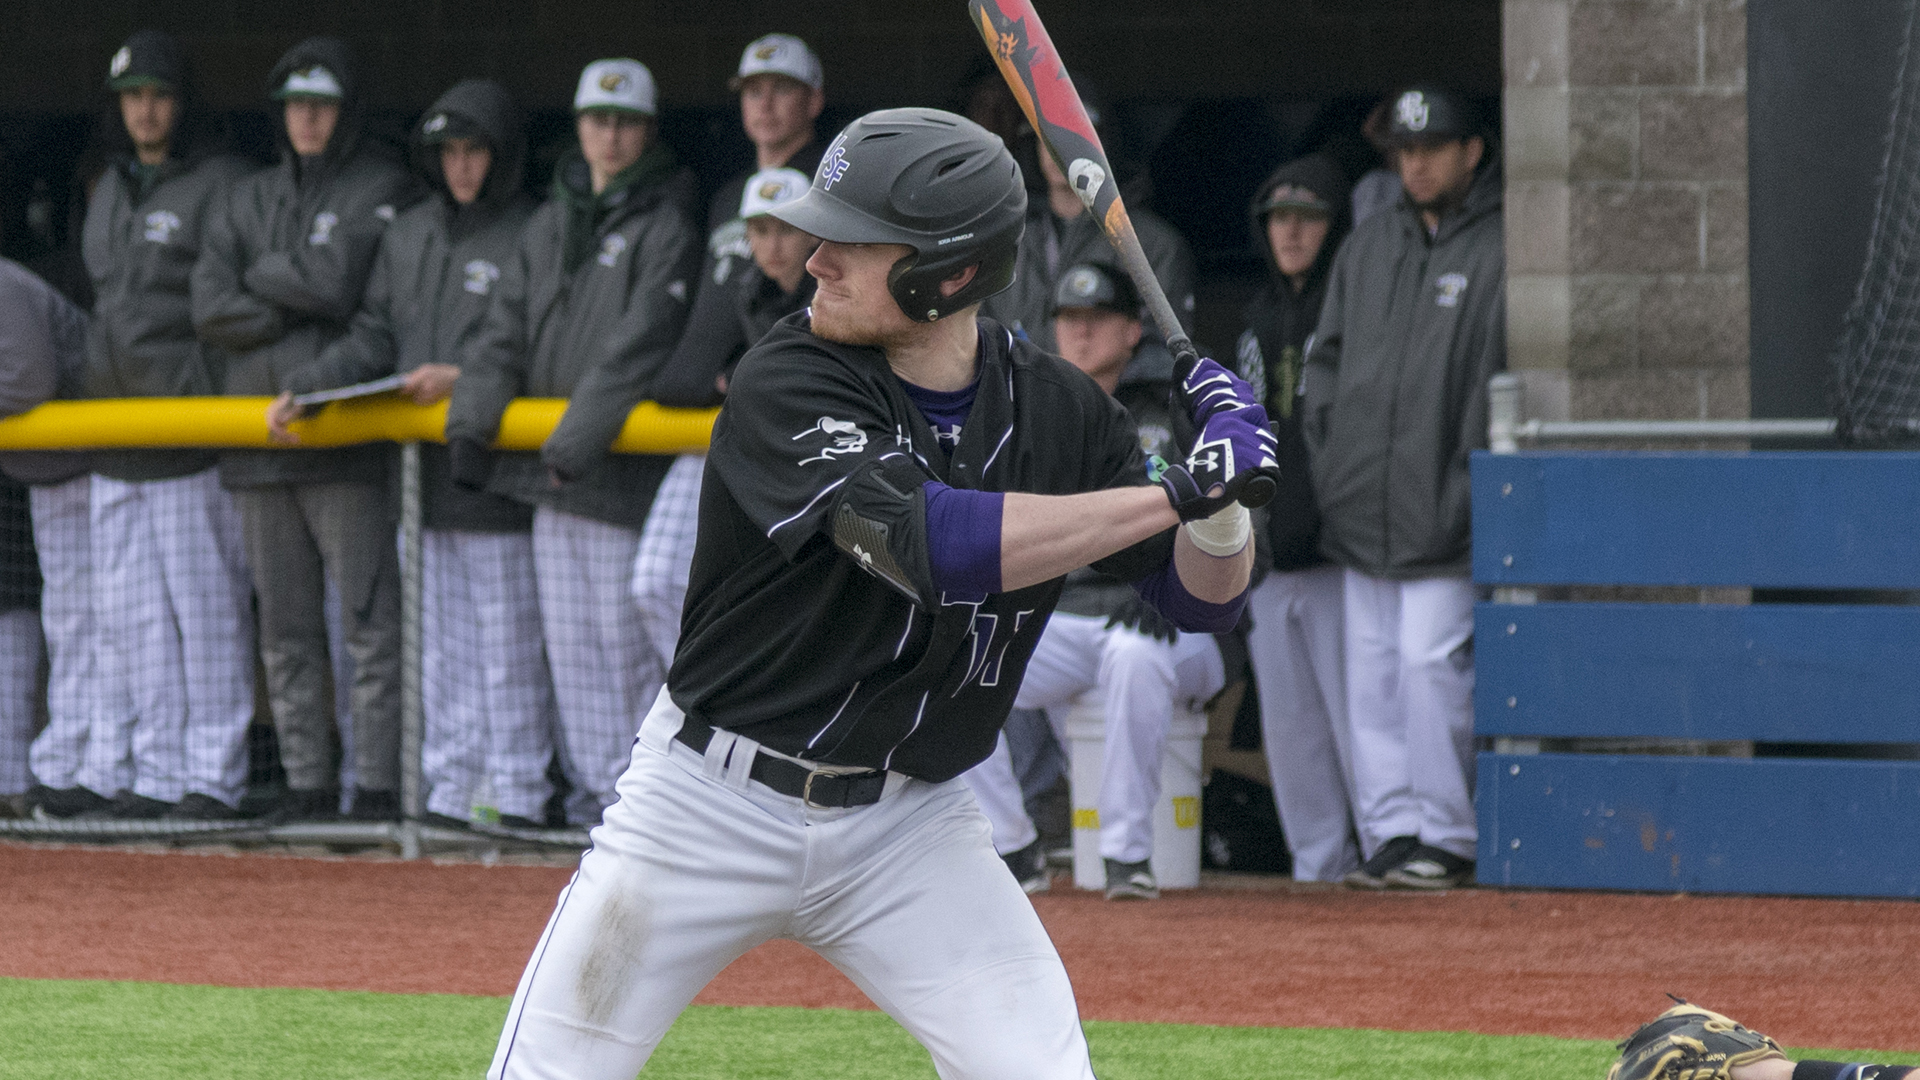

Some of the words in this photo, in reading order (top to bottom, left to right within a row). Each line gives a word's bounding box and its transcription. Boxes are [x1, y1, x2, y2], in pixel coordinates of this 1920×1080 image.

[951, 232, 974, 243] ARMOUR
[1187, 357, 1205, 380] UNDER
[1705, 1052, 1727, 1062] JAPAN
